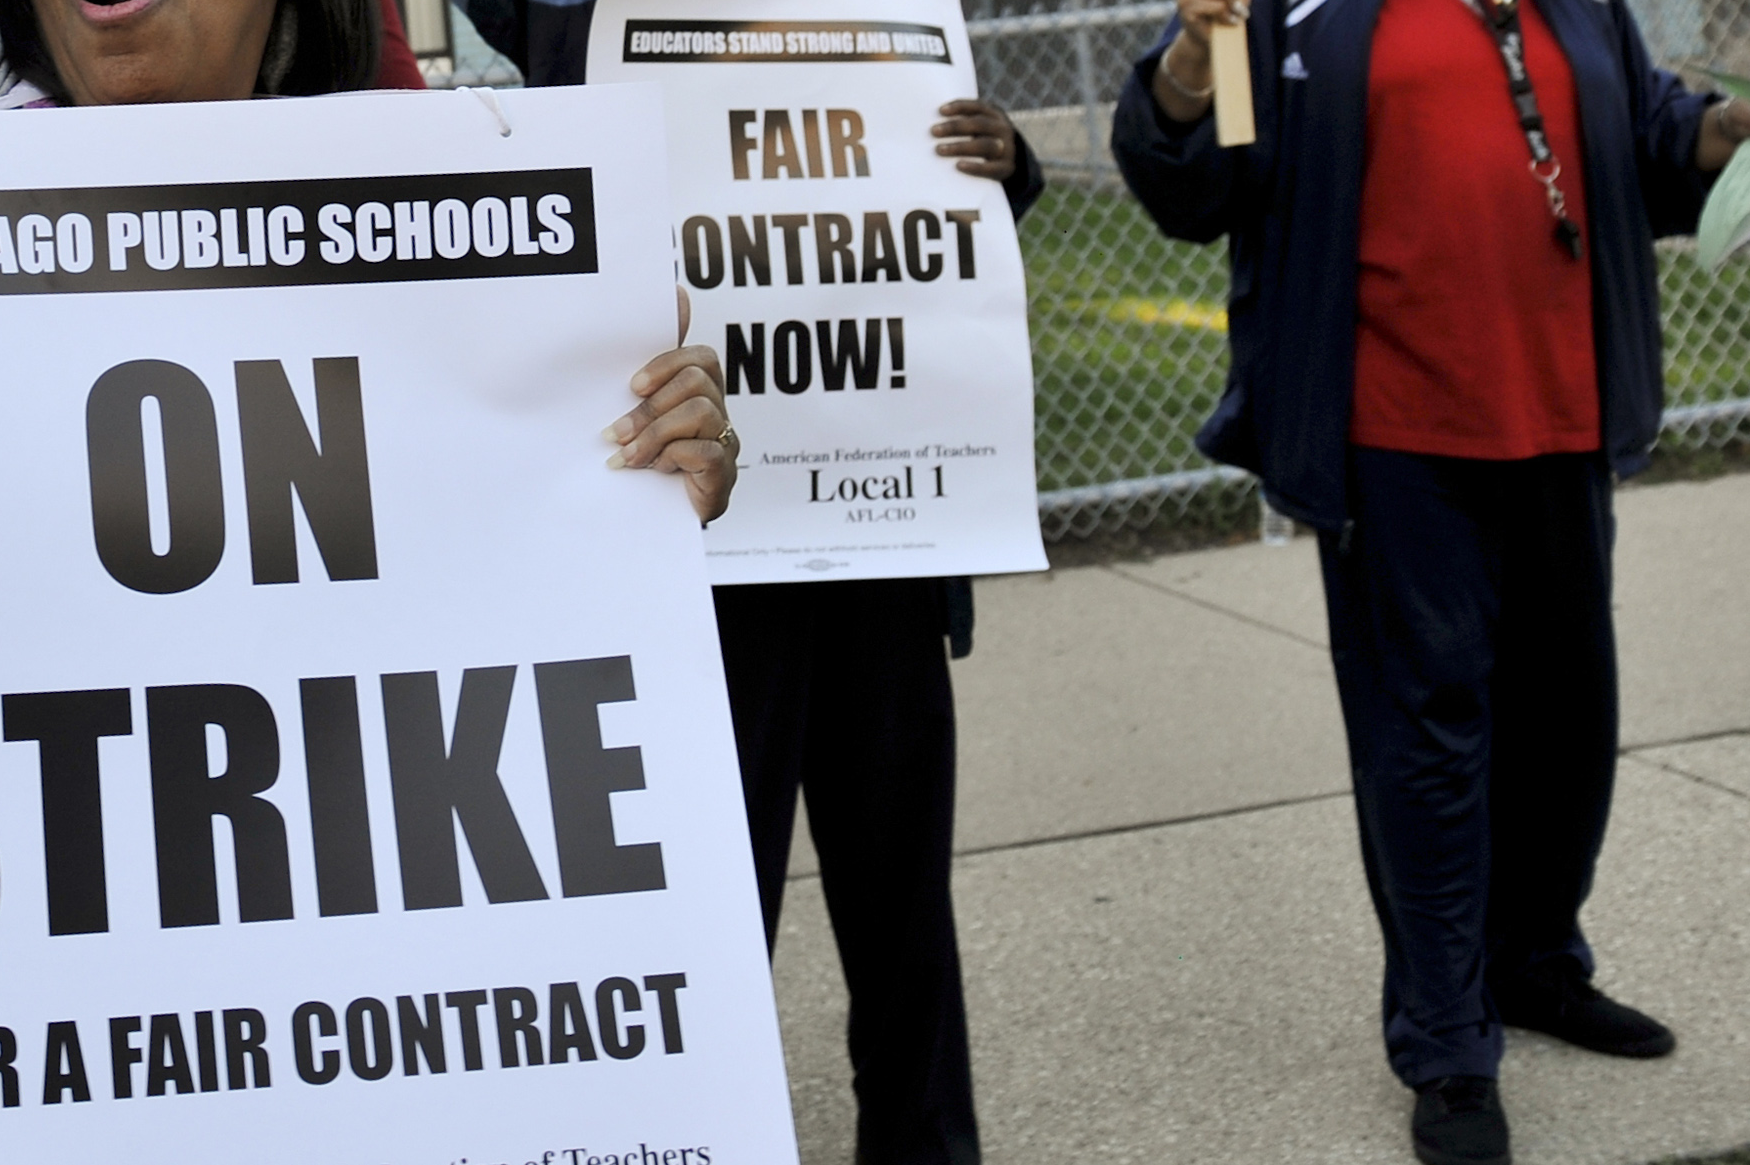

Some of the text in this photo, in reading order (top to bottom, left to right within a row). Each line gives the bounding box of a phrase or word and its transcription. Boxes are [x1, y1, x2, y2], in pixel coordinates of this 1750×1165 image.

[630, 30, 946, 58] EDUCATORS STAND STRONG AND UNITED
[727, 108, 872, 180] FAIR
[106, 204, 306, 271] PUBLIC
[317, 193, 575, 266] SCHOOLS
[671, 208, 982, 290] ONTRACT
[724, 317, 906, 397] NOW!
[84, 355, 380, 595] ON
[760, 442, 997, 466] American Federation of Teachers
[808, 464, 949, 503] Local 1
[844, 507, 916, 523] AFL-CIO
[41, 1019, 93, 1105] A
[107, 1006, 272, 1100] FAIR
[290, 971, 688, 1086] CONTRACT
